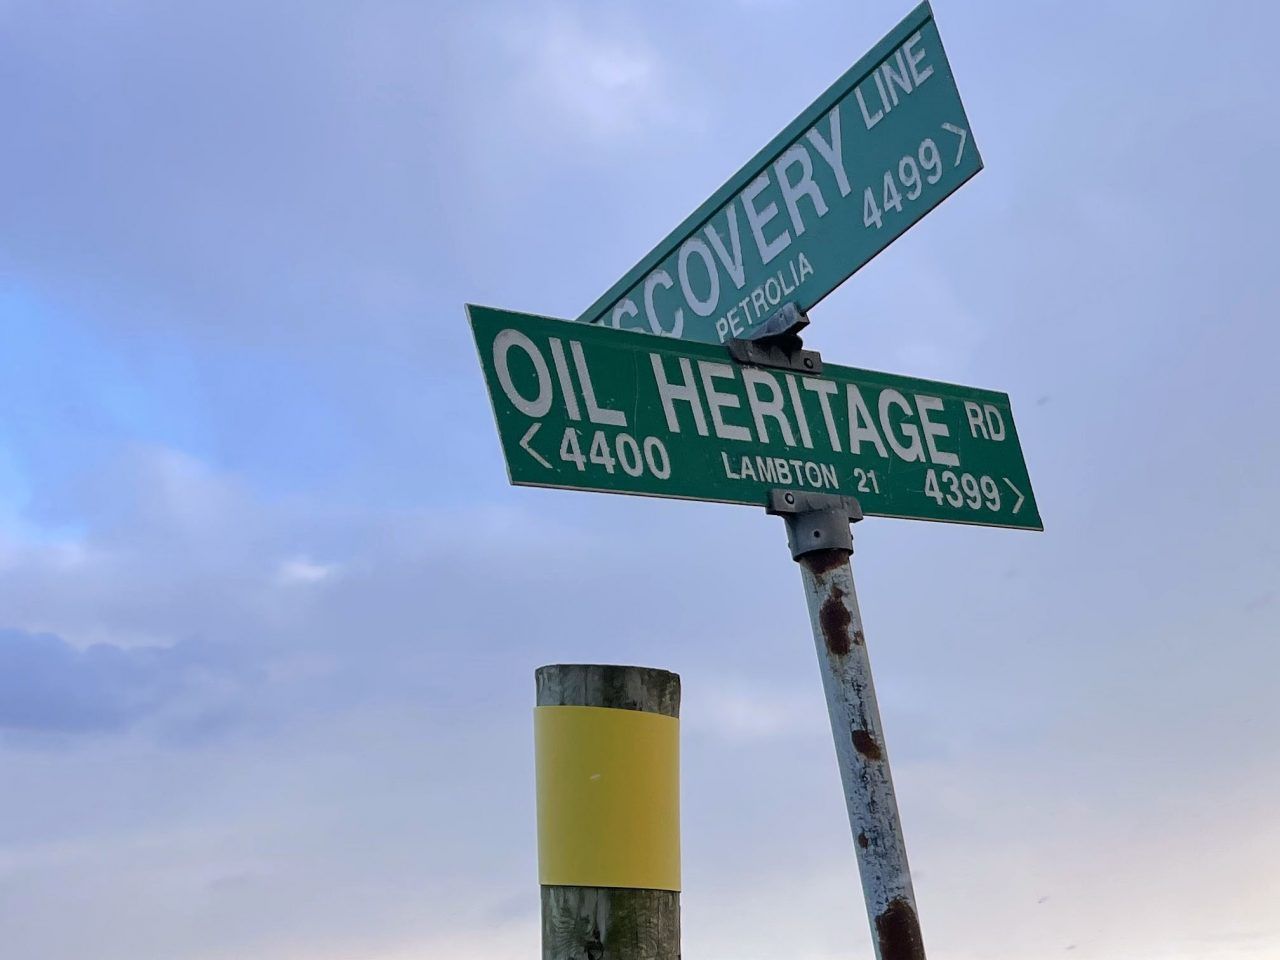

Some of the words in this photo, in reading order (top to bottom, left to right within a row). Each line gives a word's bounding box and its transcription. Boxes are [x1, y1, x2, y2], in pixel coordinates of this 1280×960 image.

[854, 31, 935, 130] LINE
[861, 137, 943, 230] 4499
[714, 252, 815, 343] PETROLIA
[492, 328, 627, 427] OIL
[648, 352, 960, 467] HERITAGE
[966, 401, 1007, 441] RD
[559, 427, 671, 480] 4400
[721, 451, 839, 490] LAMBTON
[854, 467, 880, 494] 21
[924, 468, 1001, 512] 4399
